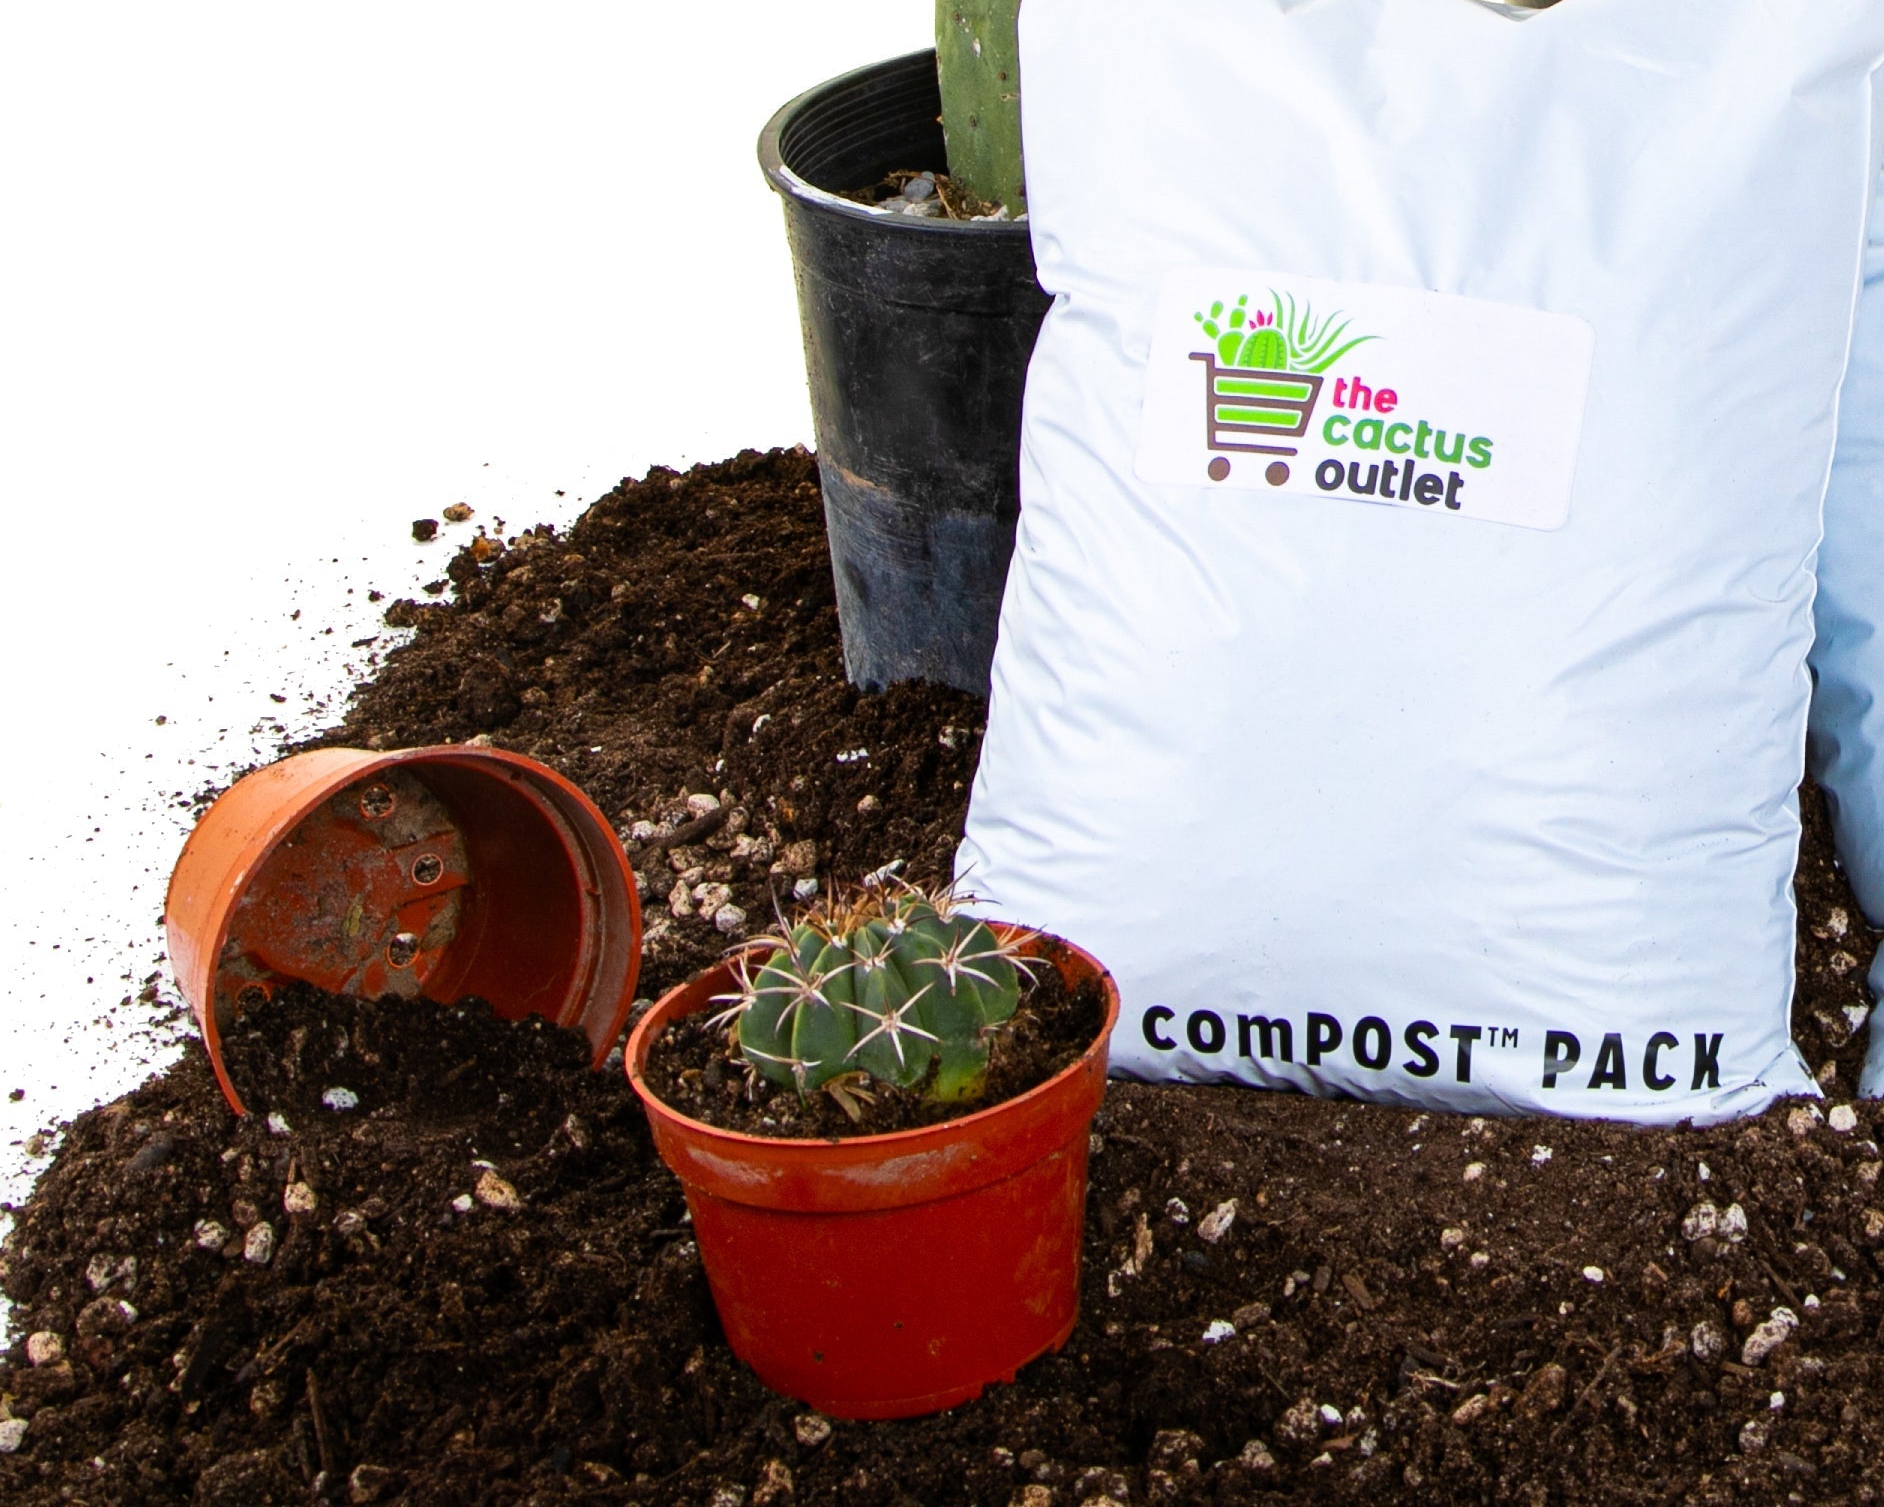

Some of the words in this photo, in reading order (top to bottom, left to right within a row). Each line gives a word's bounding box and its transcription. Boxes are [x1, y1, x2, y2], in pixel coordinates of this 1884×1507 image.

[1332, 376, 1398, 413] the
[1322, 414, 1494, 469] cactus
[1315, 458, 1464, 511] outlet
[1541, 1029, 1725, 1092] PACK
